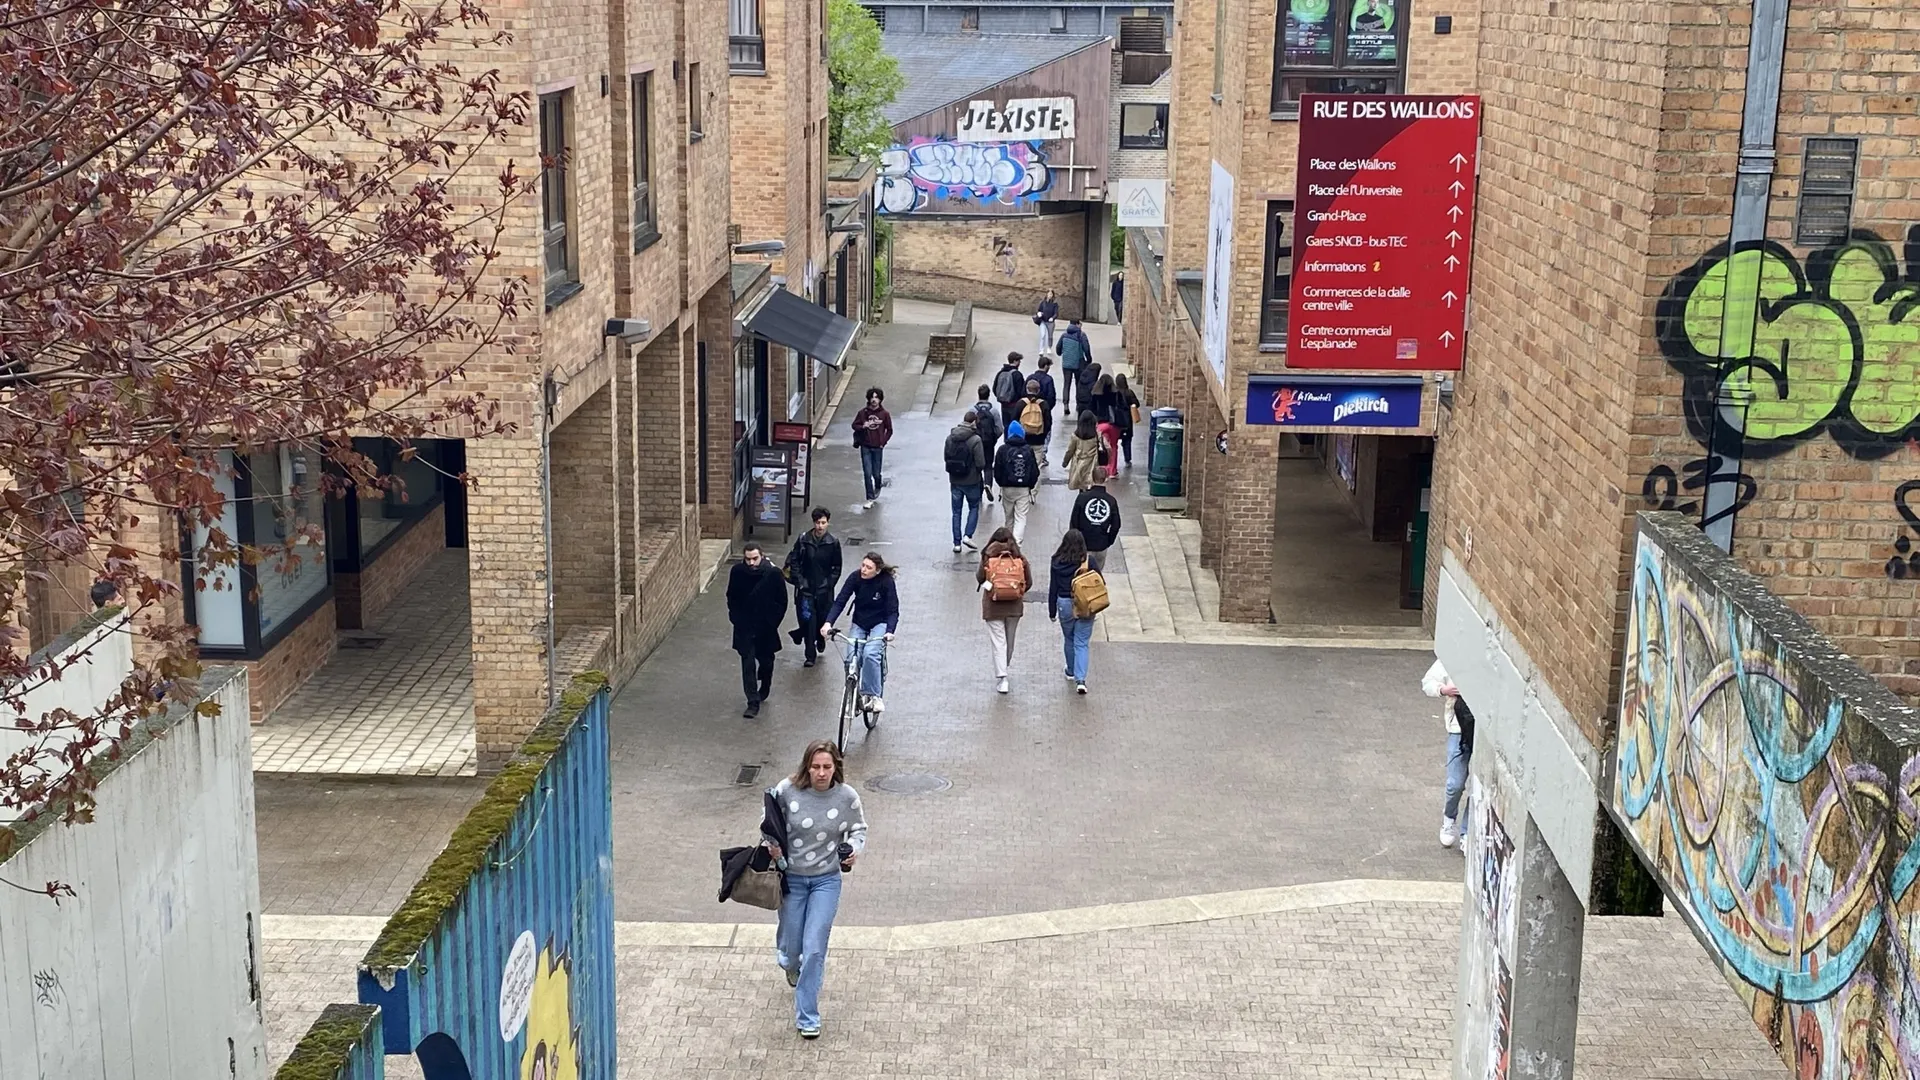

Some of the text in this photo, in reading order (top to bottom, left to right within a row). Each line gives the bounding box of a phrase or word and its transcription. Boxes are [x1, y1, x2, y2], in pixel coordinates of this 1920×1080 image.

[1313, 101, 1475, 119] RUE DES WALLONS
[1310, 158, 1397, 171] Place des Wallons
[1308, 184, 1335, 197] Place
[1335, 184, 1350, 197] de
[1307, 210, 1367, 222] Grand-Place
[1305, 235, 1334, 248] Gares
[1334, 235, 1363, 247] SNCB
[1368, 235, 1388, 247] bus
[1387, 236, 1408, 248] TEC
[1304, 261, 1367, 273] Informations
[1302, 285, 1411, 298] Commerces de la dalle
[1302, 300, 1354, 311] centre ville
[1301, 324, 1393, 337] Centre commercial
[1300, 337, 1358, 351] L'esplanade
[1333, 397, 1389, 423] Diekirch
